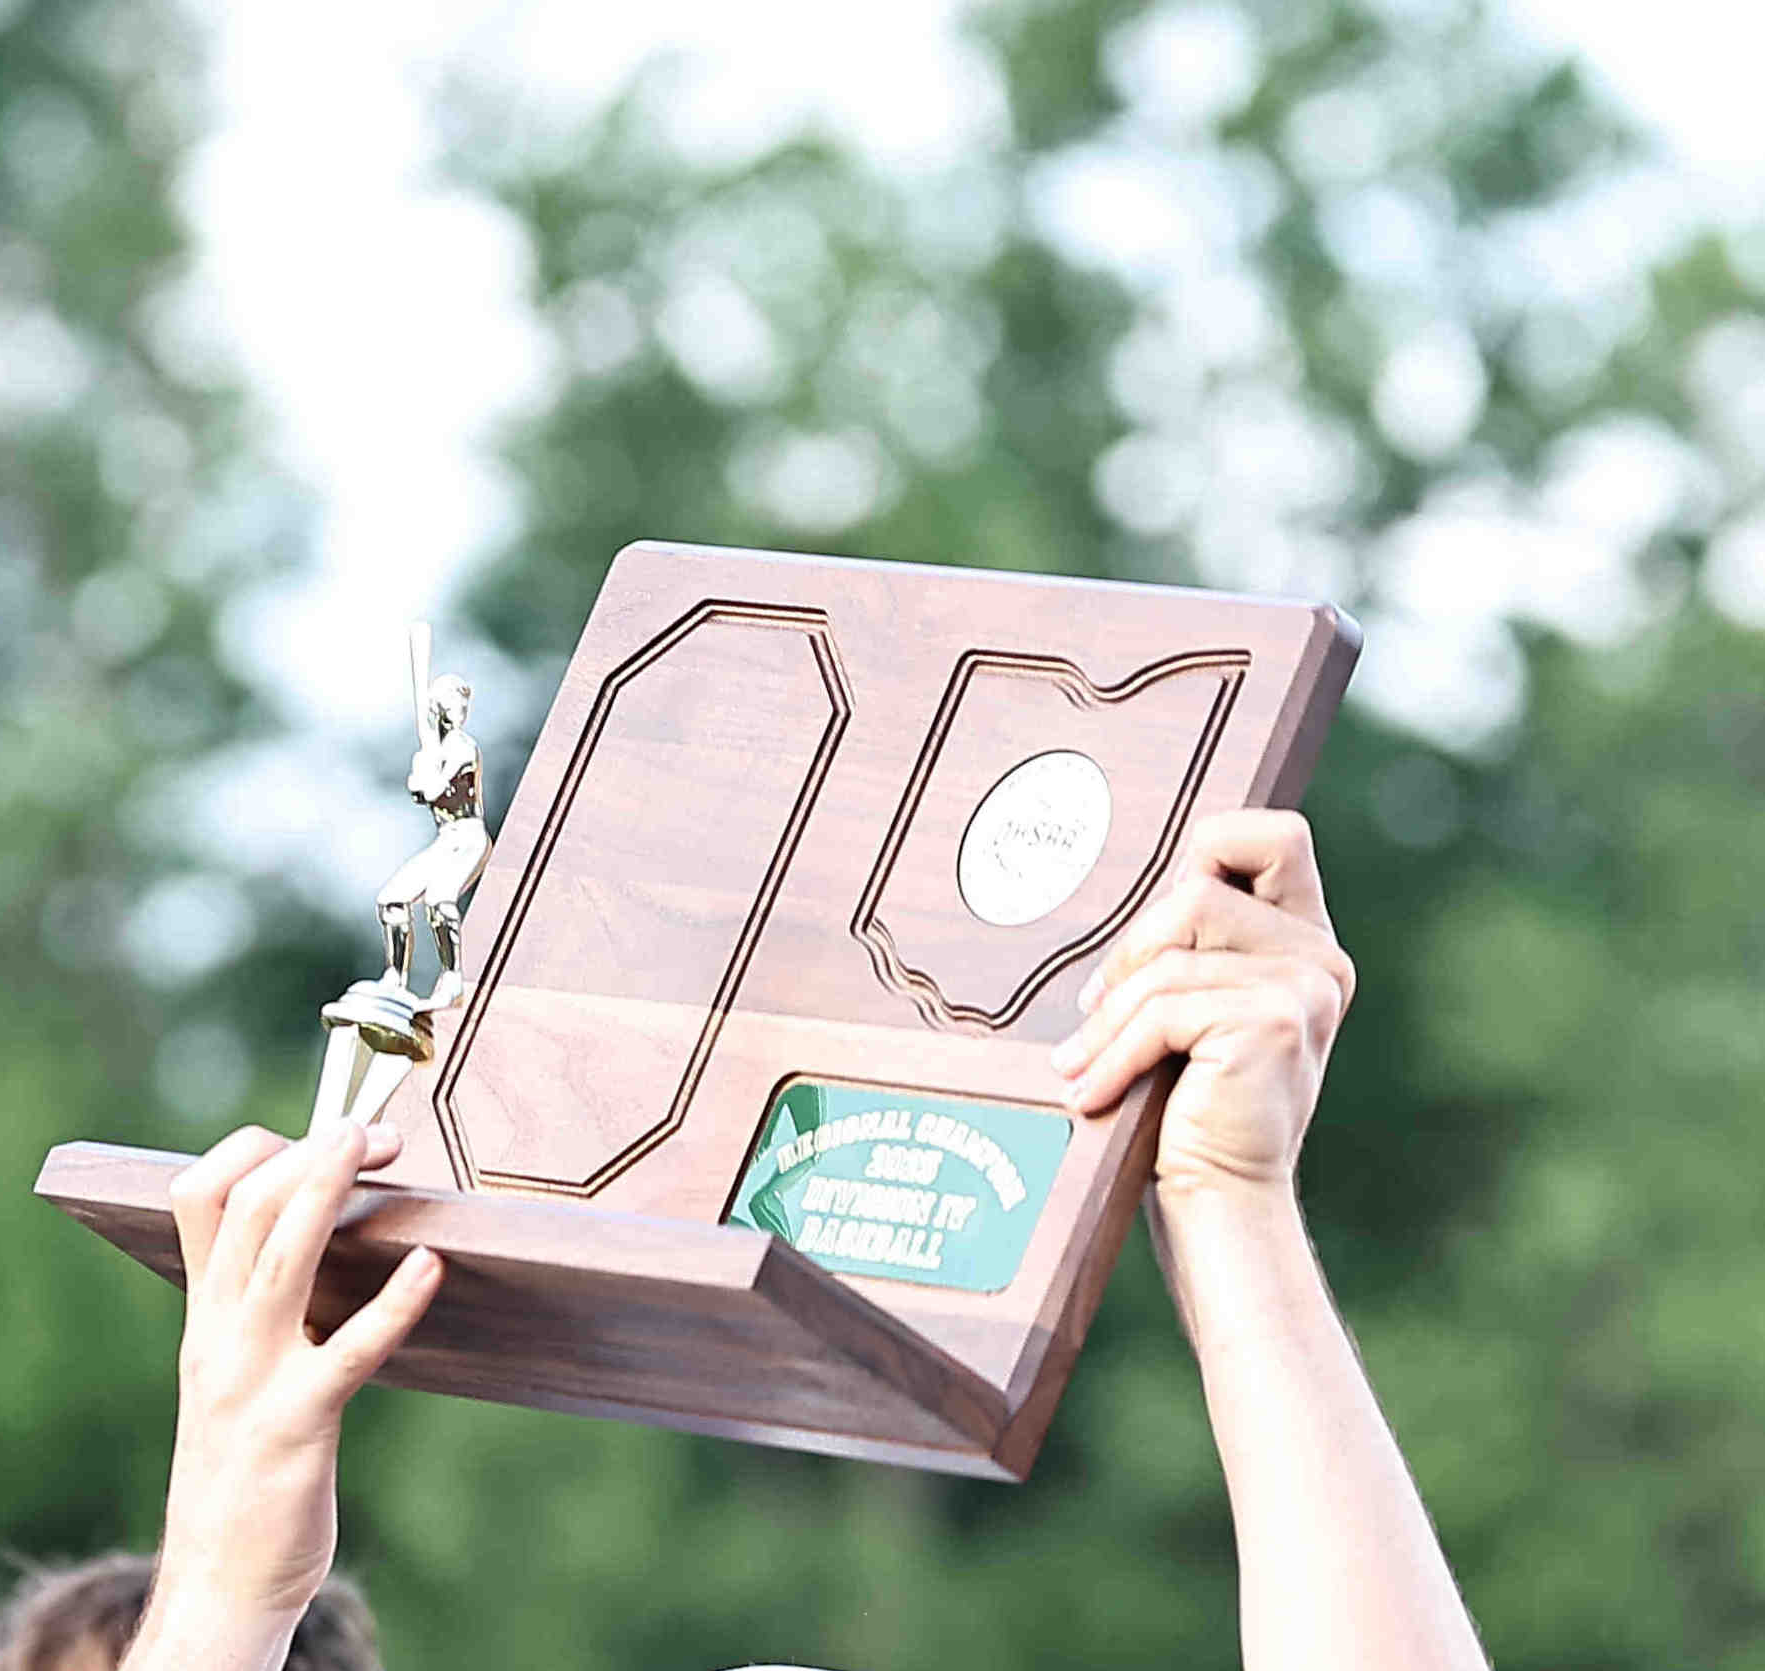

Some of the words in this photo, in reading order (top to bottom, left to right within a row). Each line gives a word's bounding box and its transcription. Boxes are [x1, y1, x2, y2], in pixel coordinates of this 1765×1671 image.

[914, 1112, 1026, 1211] CHAMPION
[802, 1177, 939, 1226] DIVISION
[933, 1193, 977, 1231] IV
[795, 1215, 944, 1270] BASEBALL
